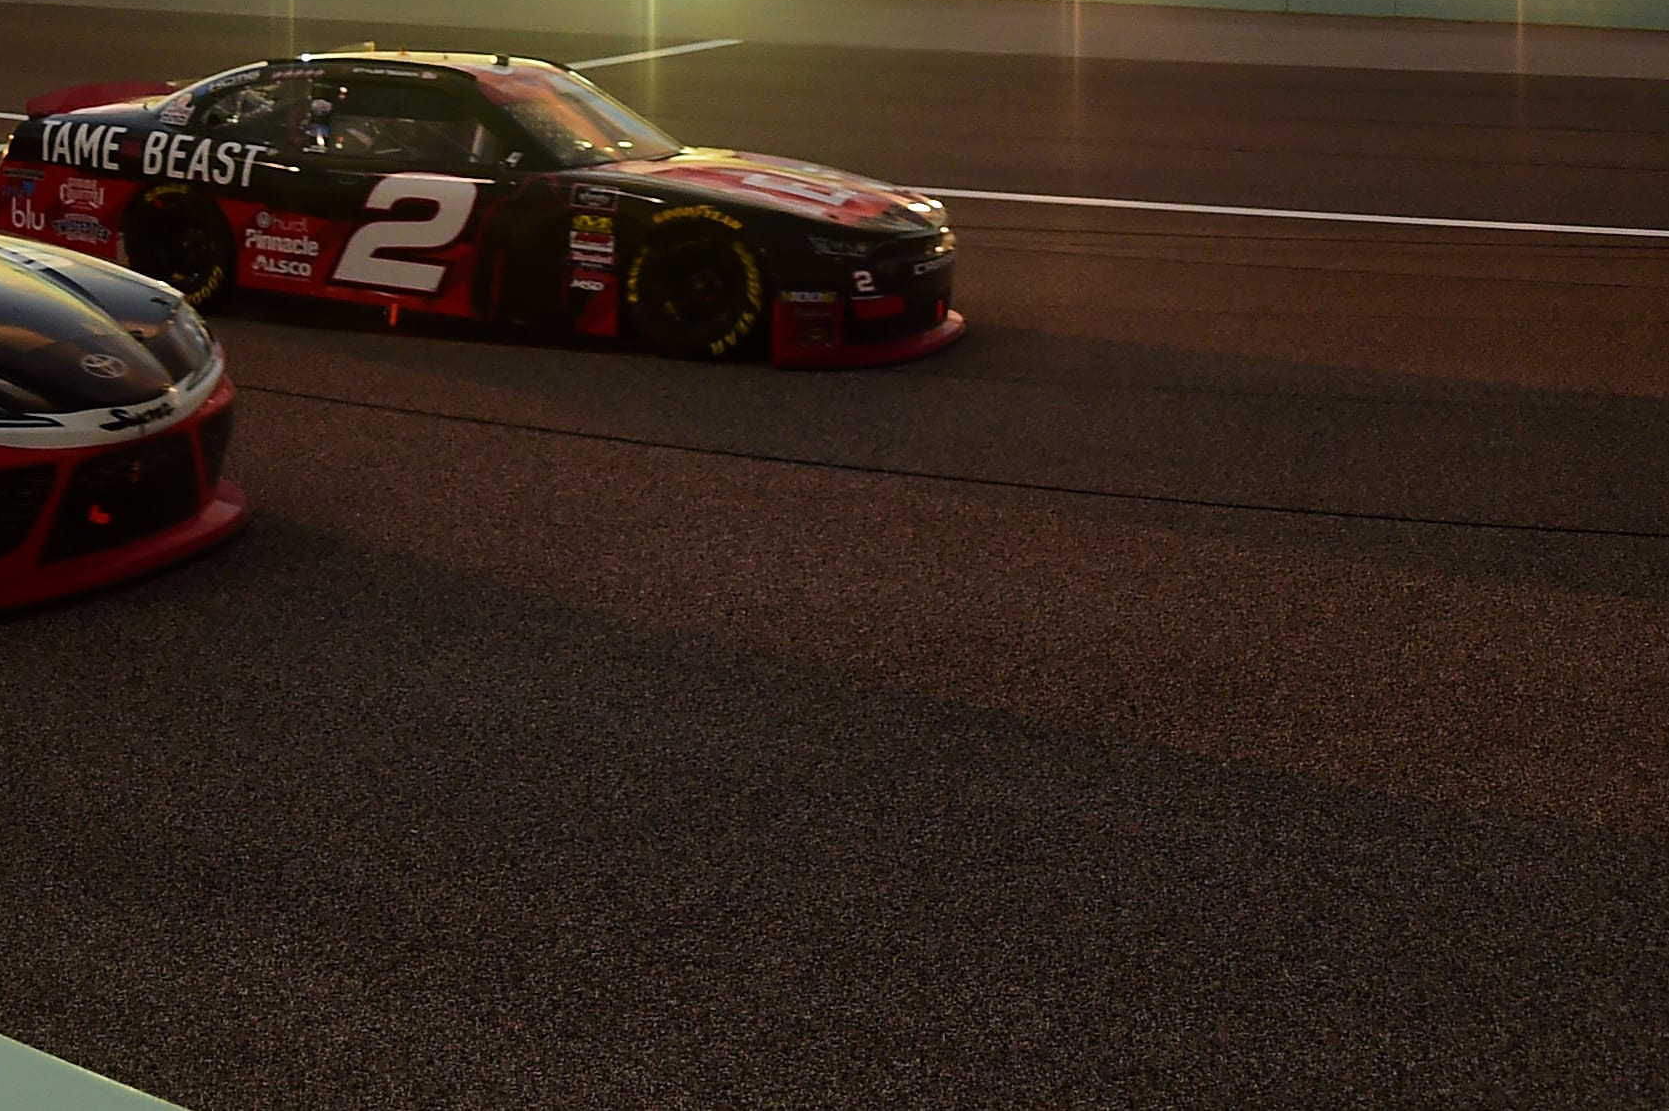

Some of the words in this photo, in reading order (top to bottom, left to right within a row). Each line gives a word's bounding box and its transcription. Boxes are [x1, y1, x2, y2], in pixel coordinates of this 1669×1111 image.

[41, 120, 128, 171] TAME
[142, 130, 268, 188] BEAST
[11, 196, 46, 231] blu
[245, 228, 320, 257] Pinnacle
[334, 172, 477, 293] 2
[852, 269, 877, 292] 2
